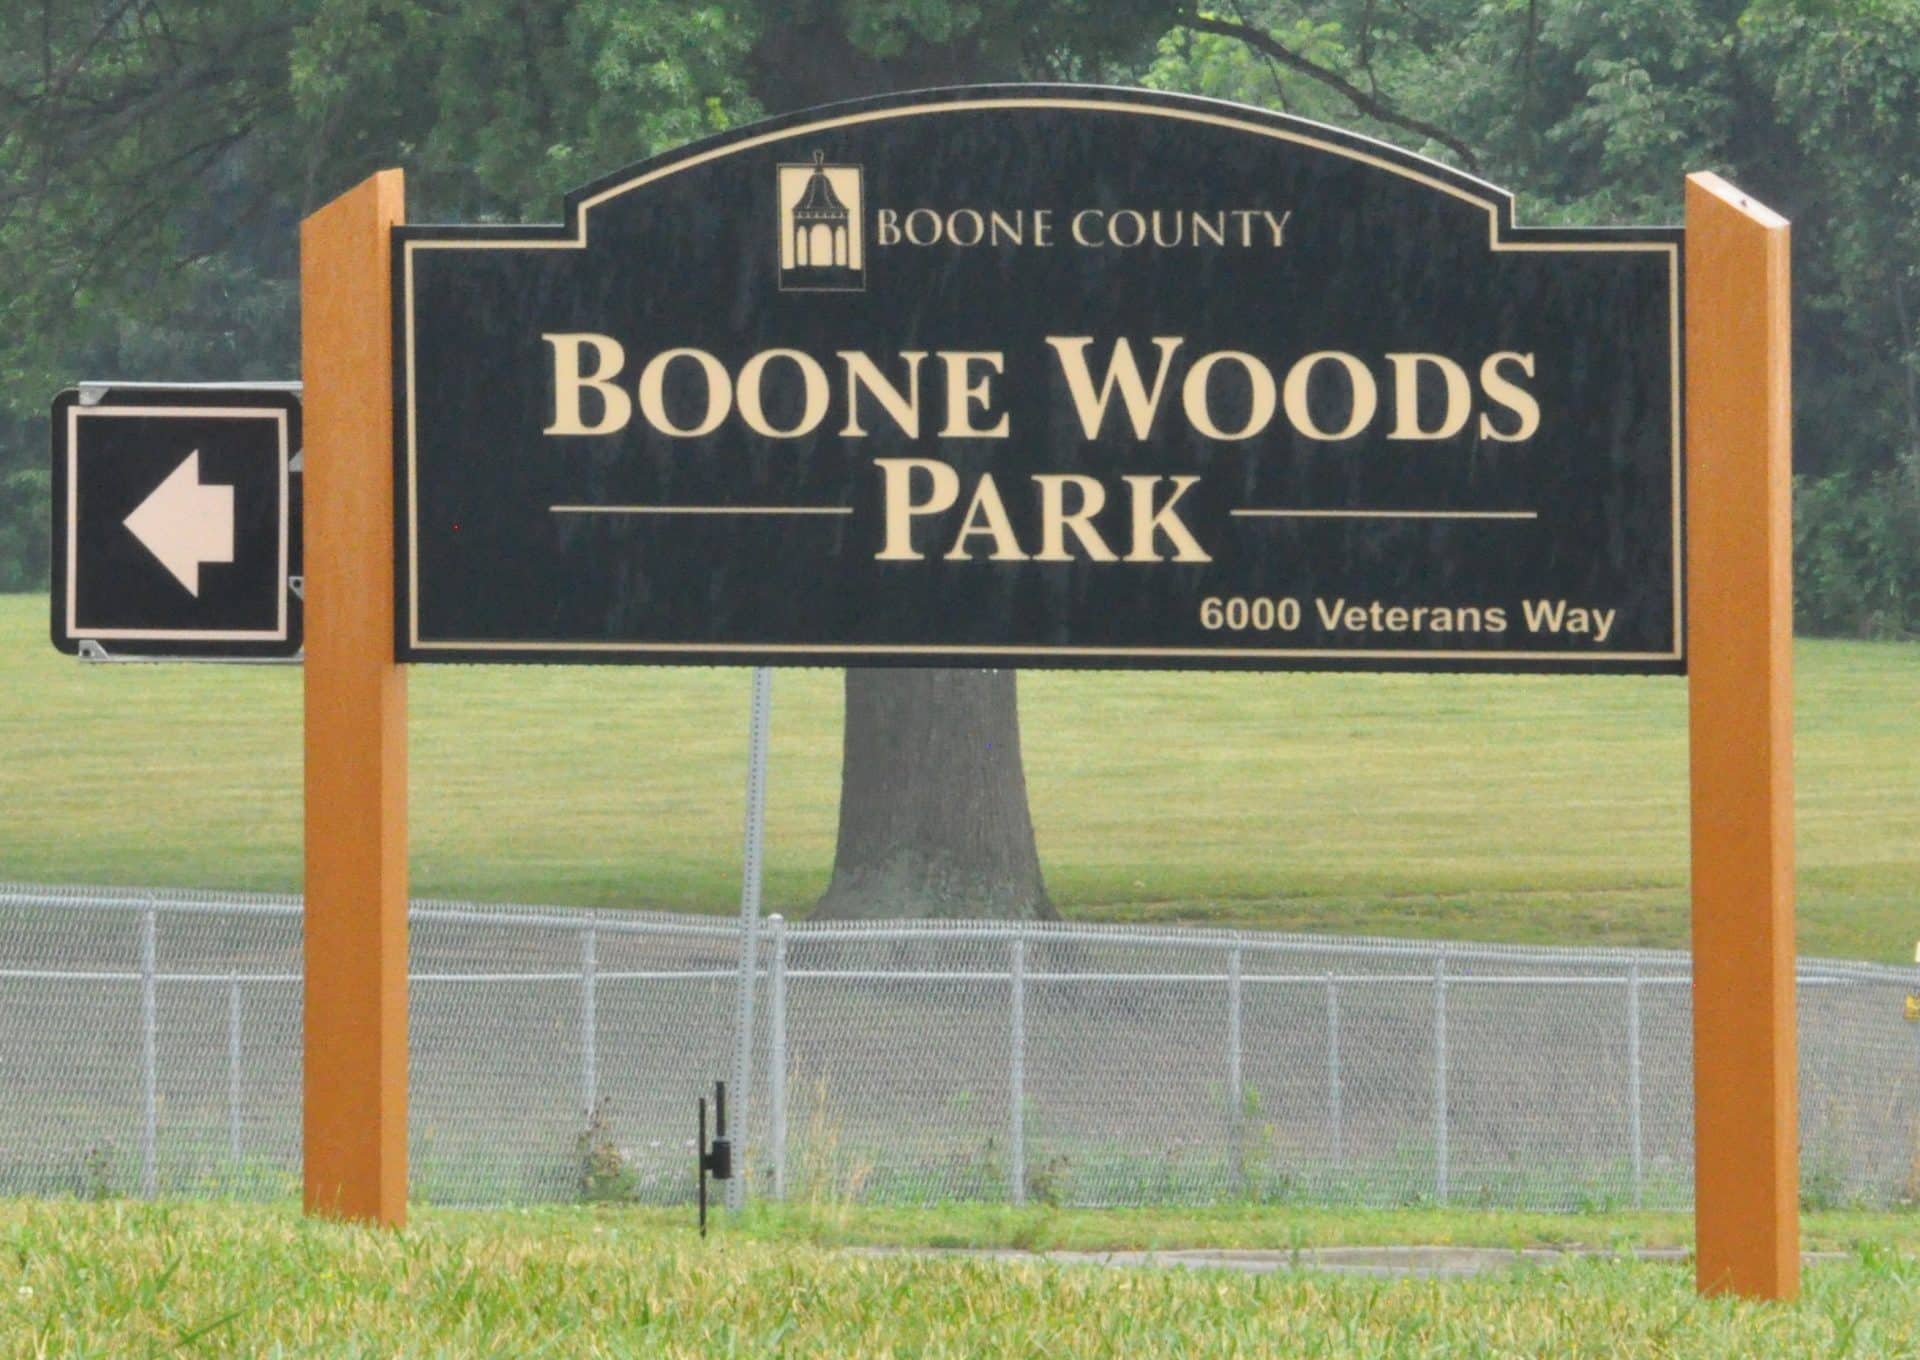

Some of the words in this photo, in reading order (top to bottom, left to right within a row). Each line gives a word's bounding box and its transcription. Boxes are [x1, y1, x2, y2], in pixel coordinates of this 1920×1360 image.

[877, 207, 1053, 247] BOONE
[1070, 208, 1292, 248] COUNTY
[541, 332, 1010, 439] BOONE
[1045, 335, 1541, 443] WOODS
[873, 457, 1213, 563] PARK
[1199, 596, 1302, 631] 6000
[1315, 598, 1508, 633] Veterans
[1522, 599, 1617, 642] Way
